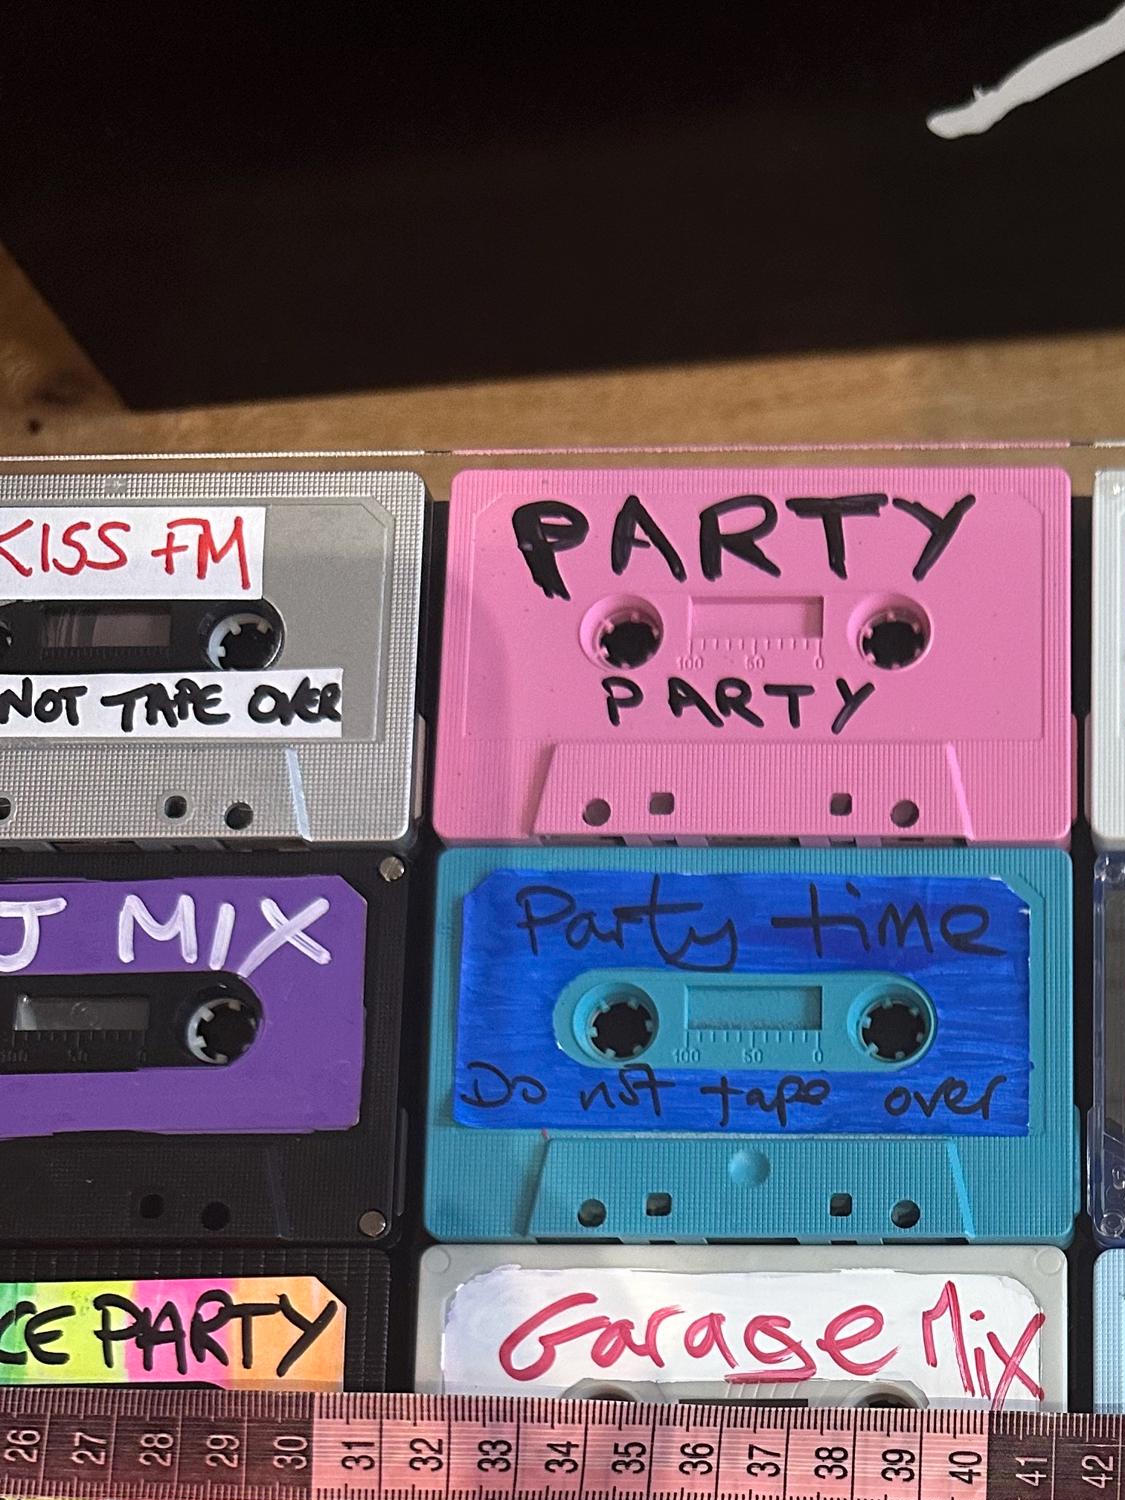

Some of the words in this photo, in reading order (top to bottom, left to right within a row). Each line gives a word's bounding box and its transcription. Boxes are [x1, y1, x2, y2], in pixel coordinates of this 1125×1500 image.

[0, 519, 130, 576] KISS
[151, 516, 250, 590] FM
[511, 494, 976, 600] PARTY
[0, 677, 87, 727] NOT
[101, 678, 231, 732] TAPE
[247, 676, 342, 727] OVER
[602, 677, 875, 734] PARTY
[117, 894, 333, 978] MIX
[515, 874, 737, 972] Party
[770, 882, 1006, 958] time
[672, 1048, 701, 1064] 100
[742, 1048, 763, 1064] 50
[812, 1049, 824, 1064] 0
[459, 1061, 547, 1109] Do
[579, 1063, 675, 1117] not
[700, 1075, 831, 1127] tape
[883, 1075, 1008, 1119] over
[92, 1288, 339, 1378] PARTY
[498, 1291, 899, 1385] Garage
[922, 1280, 1047, 1411] Mix
[4, 1430, 41, 1463] 26
[71, 1432, 107, 1465] 27
[139, 1432, 174, 1467] 28
[206, 1434, 240, 1467] 29
[273, 1436, 308, 1470] 30
[341, 1440, 375, 1471] 31
[410, 1438, 443, 1472] 32
[478, 1439, 512, 1473] 33
[544, 1440, 580, 1474] 34
[612, 1440, 647, 1474] 35
[678, 1441, 714, 1475] 36
[746, 1443, 781, 1478] 37
[814, 1445, 849, 1480] 38
[881, 1448, 916, 1482] 39
[949, 1450, 983, 1484] 40
[1016, 1454, 1048, 1488] 41
[1081, 1454, 1115, 1489] 42
